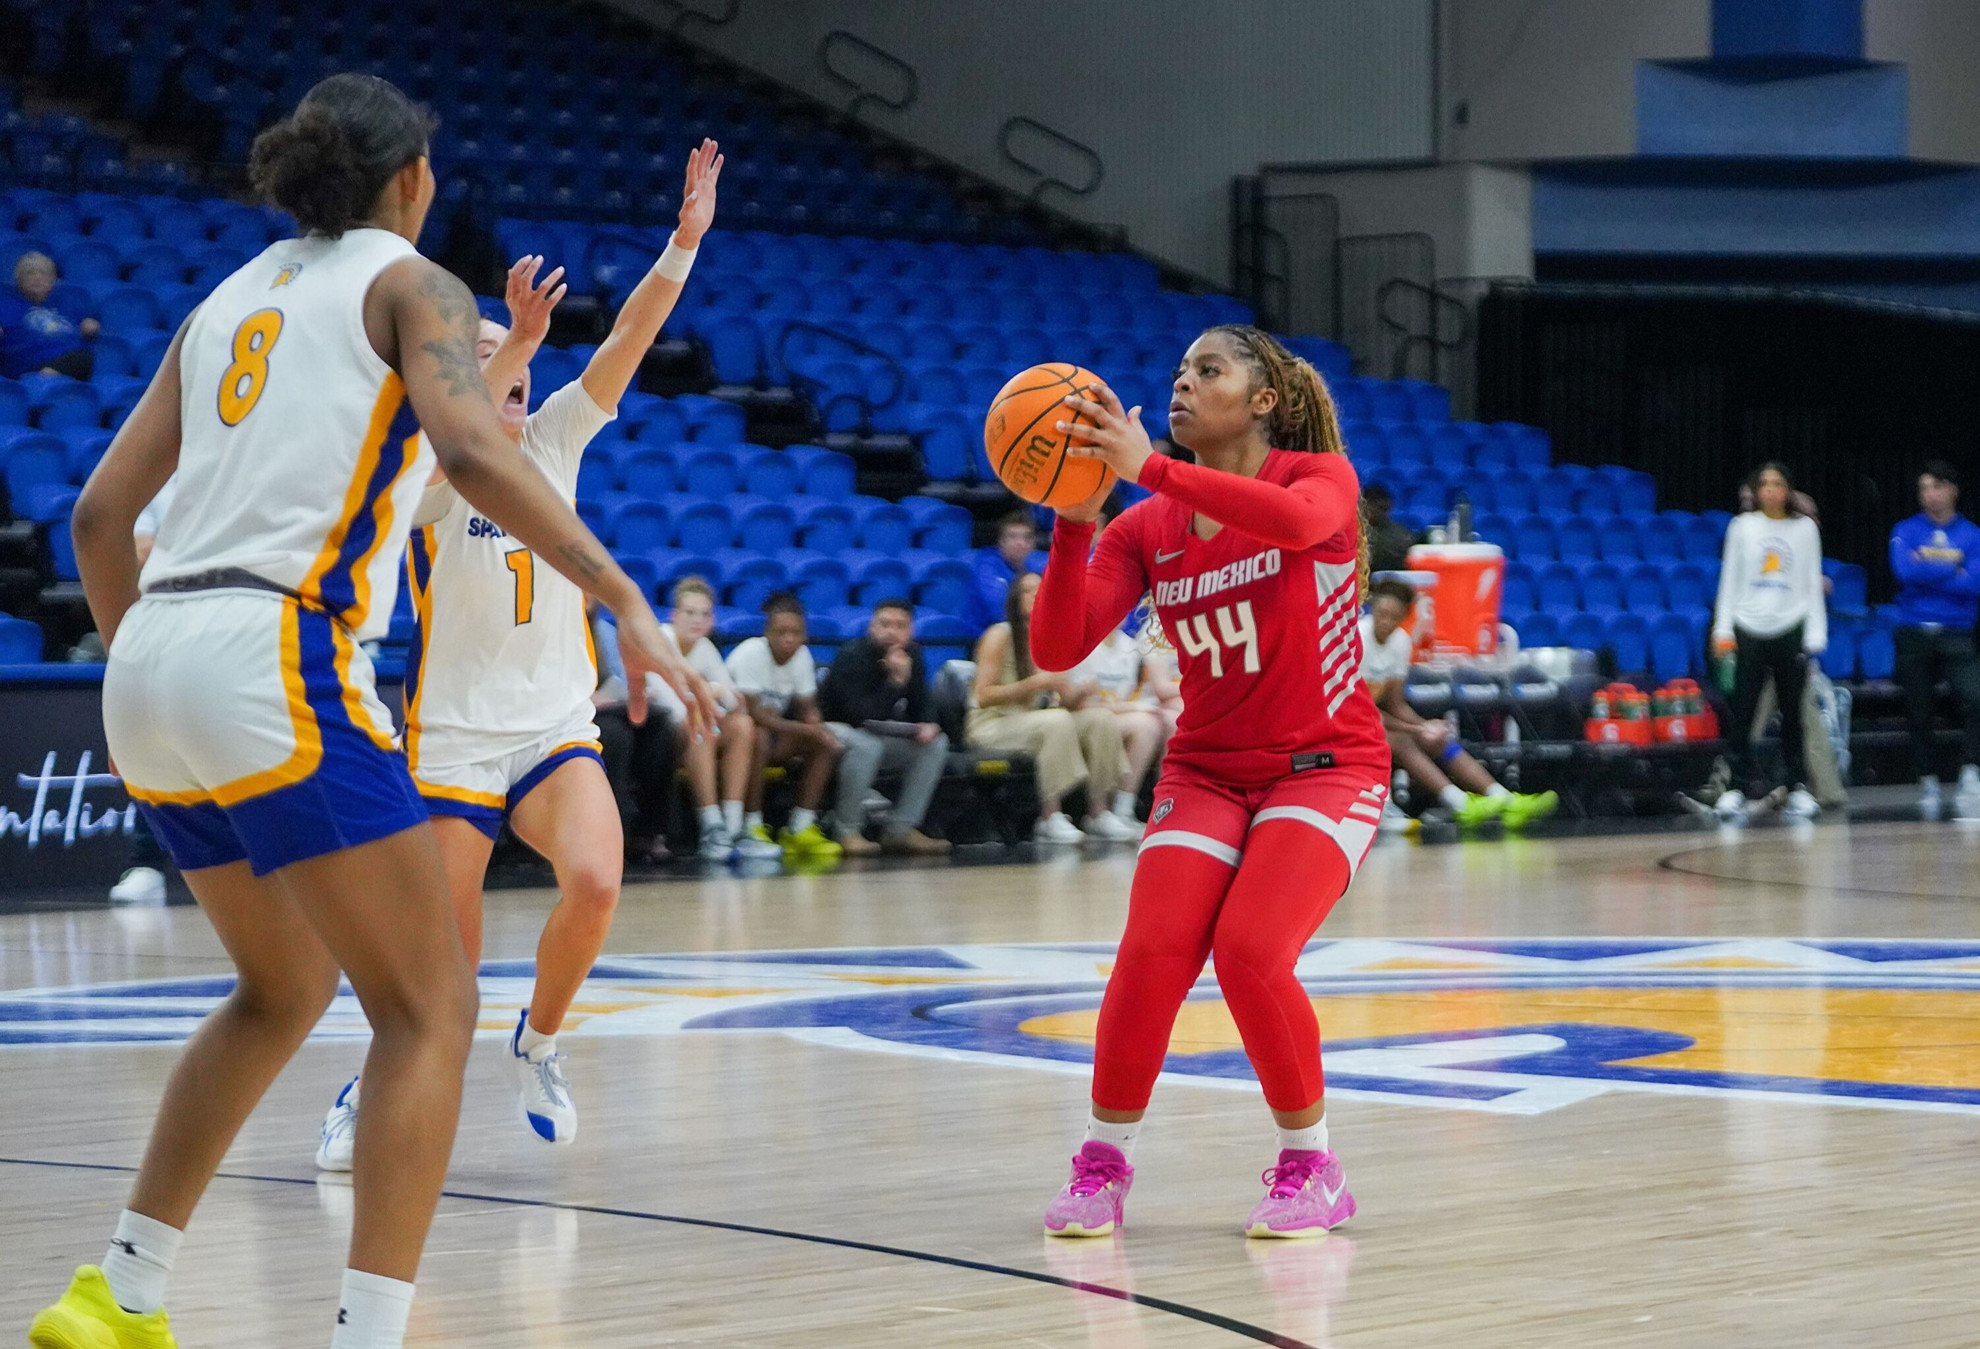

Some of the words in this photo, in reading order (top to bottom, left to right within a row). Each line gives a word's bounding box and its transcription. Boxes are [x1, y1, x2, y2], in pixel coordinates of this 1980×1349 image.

[217, 307, 284, 427] 8
[468, 516, 507, 539] SPA
[505, 548, 534, 627] 1
[1156, 576, 1194, 606] NEW
[1196, 548, 1281, 600] MEXICO
[1176, 599, 1261, 678] 44
[1321, 756, 1330, 765] M
